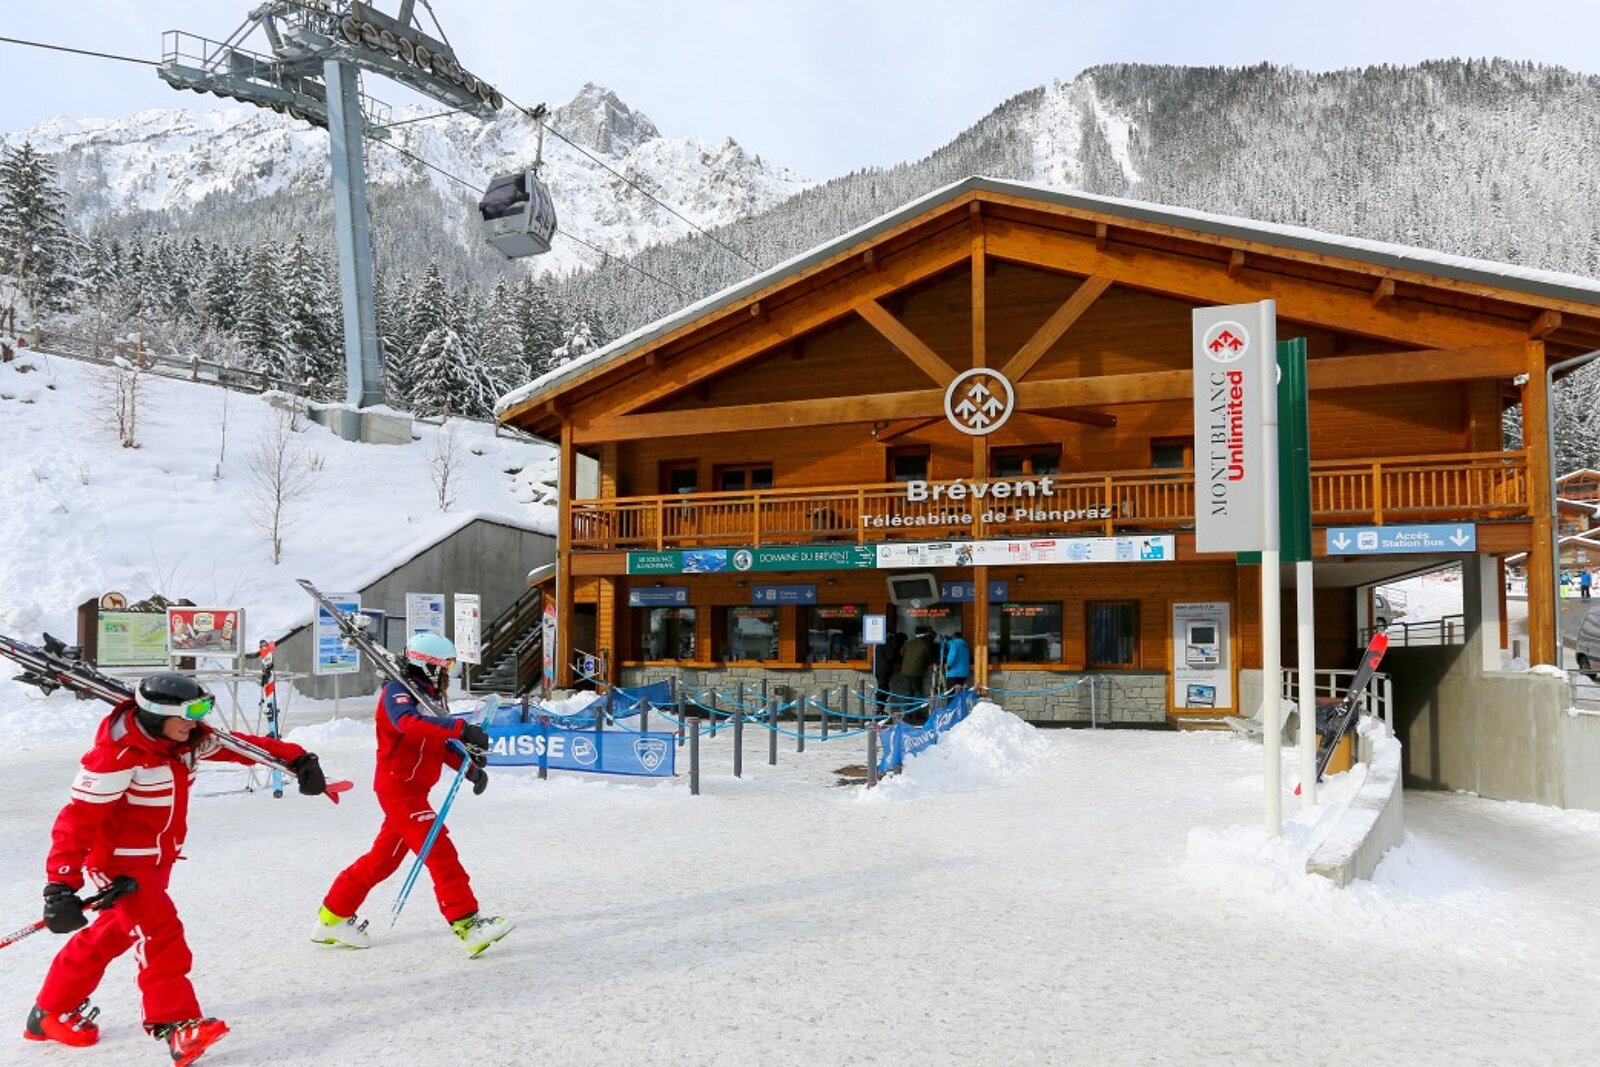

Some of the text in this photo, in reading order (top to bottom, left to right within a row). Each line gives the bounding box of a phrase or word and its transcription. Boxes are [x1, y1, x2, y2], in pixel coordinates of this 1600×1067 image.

[1226, 370, 1244, 482] Unlimited
[1210, 372, 1227, 516] MONT BLANC
[907, 476, 1055, 502] Brévent
[860, 507, 1113, 527] Télécabine de Planpraz
[1382, 538, 1444, 548] Station bus
[1395, 531, 1430, 540] Accès
[760, 552, 799, 562] DOMAINE
[801, 552, 813, 561] DU
